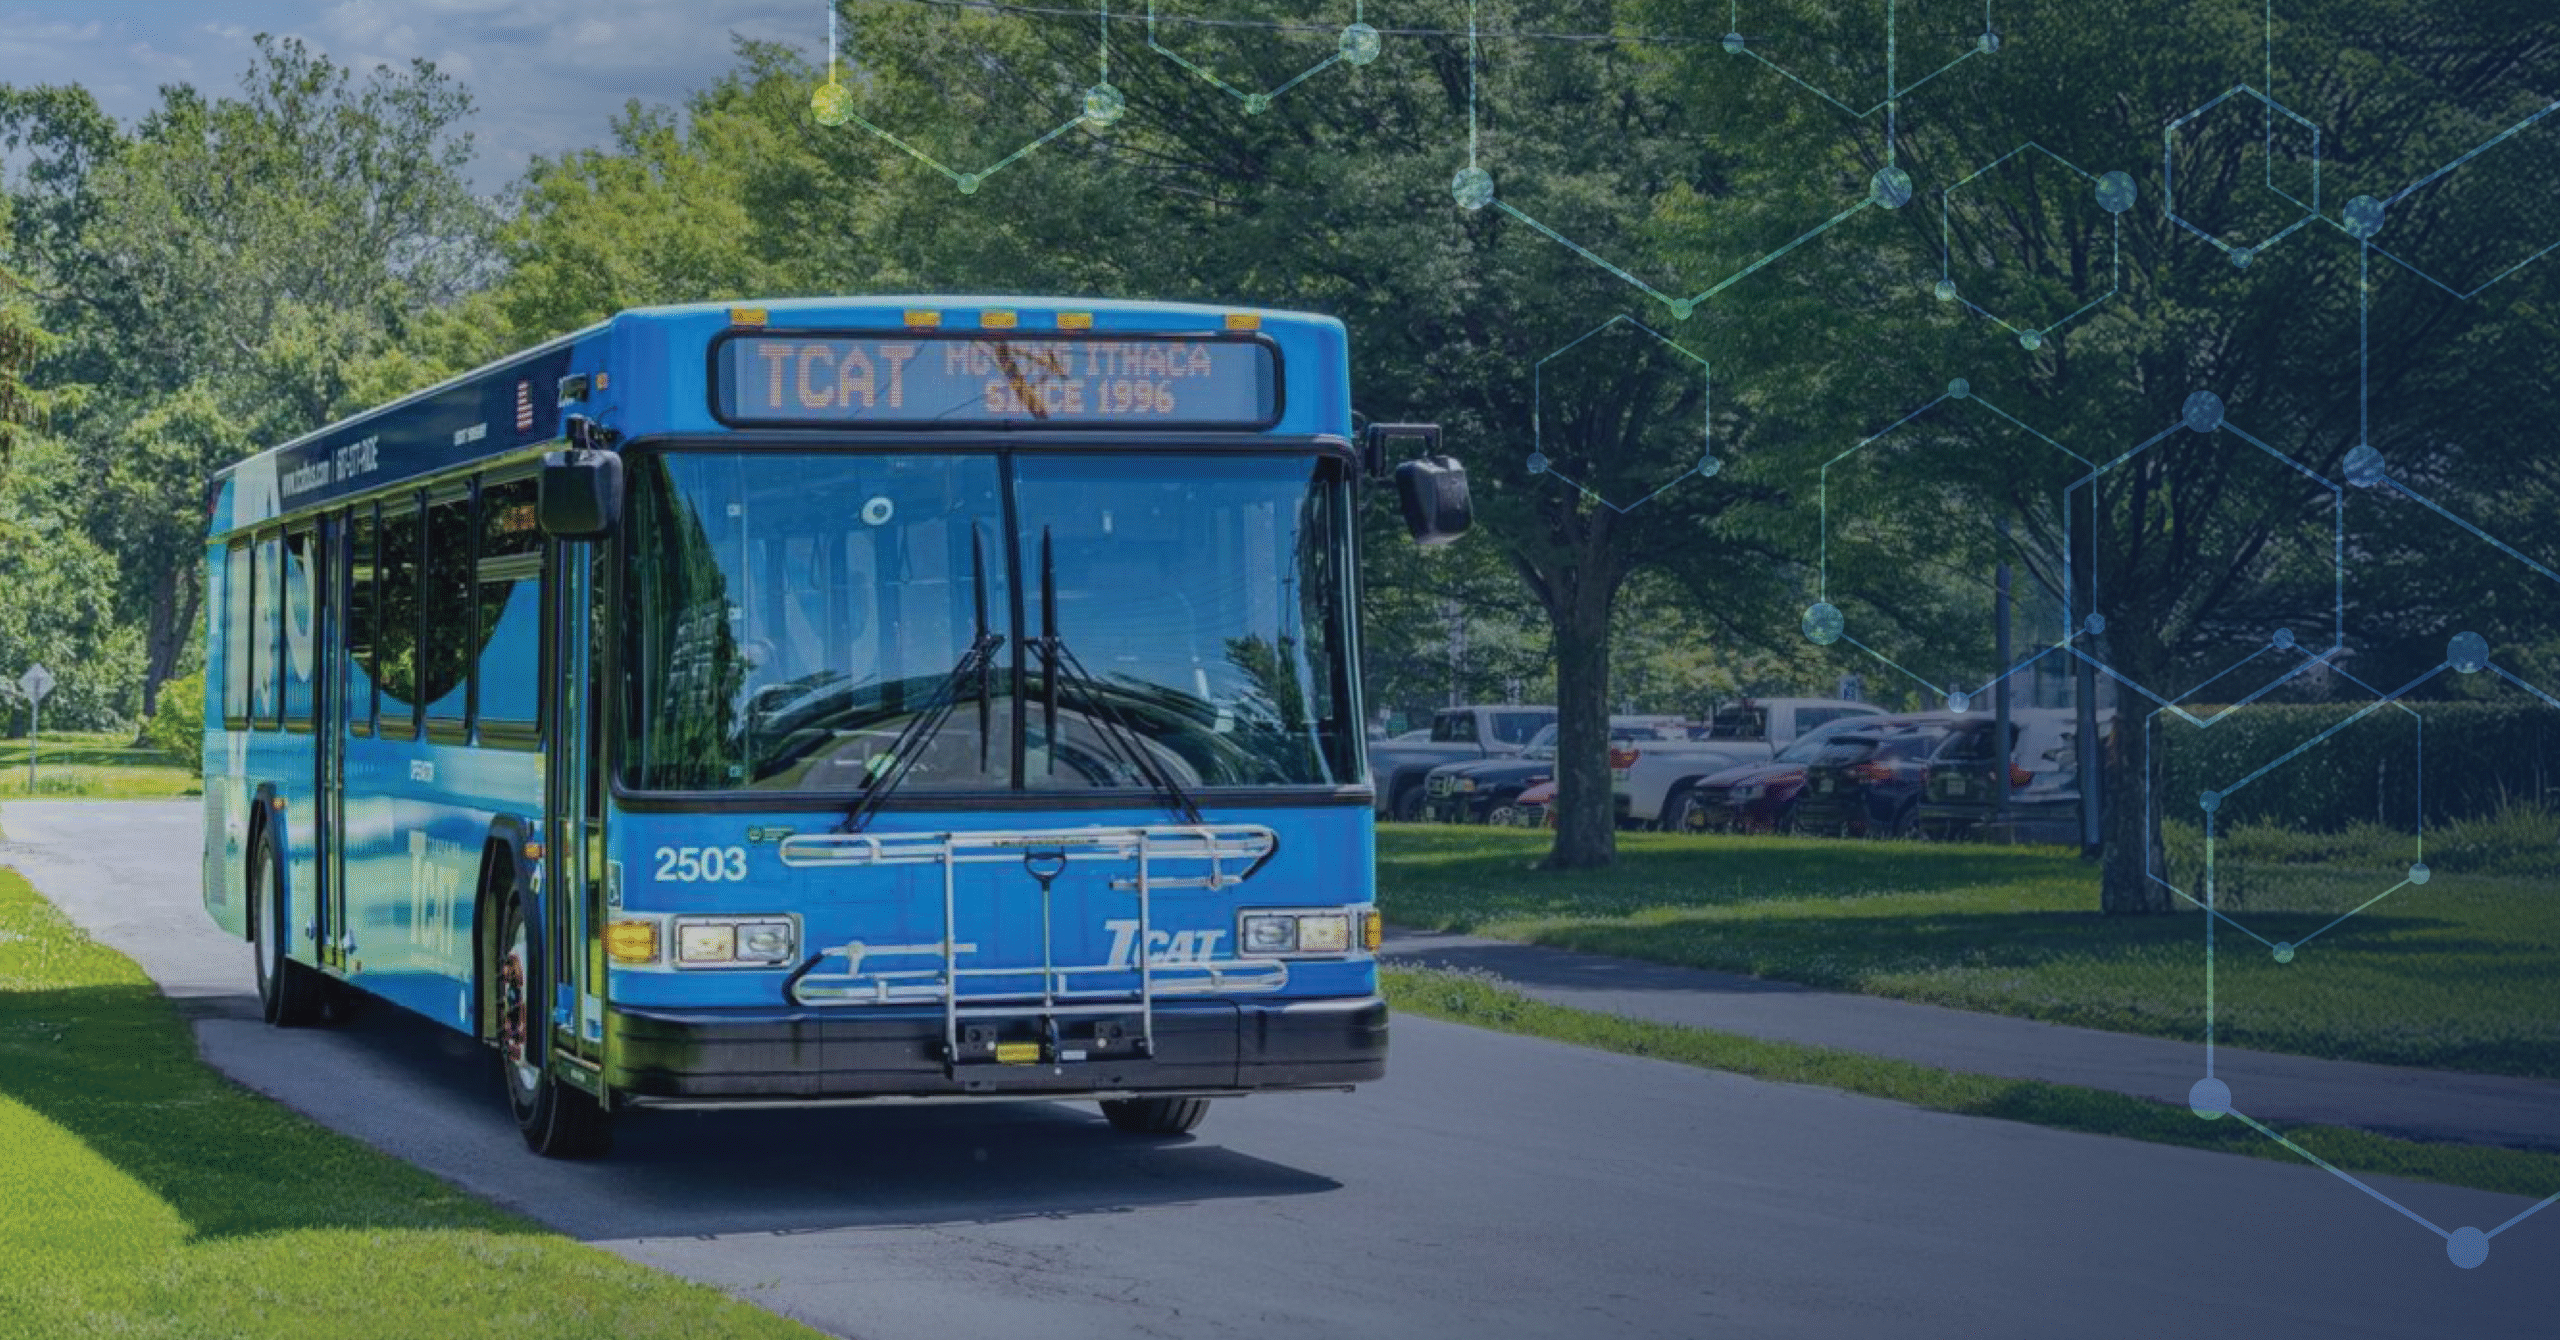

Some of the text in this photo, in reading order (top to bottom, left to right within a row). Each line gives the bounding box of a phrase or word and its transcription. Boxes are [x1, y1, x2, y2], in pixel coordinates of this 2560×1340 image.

[1087, 341, 1211, 376] ITHACA
[759, 345, 915, 408] TCAT
[1098, 379, 1175, 413] 1996
[655, 846, 747, 882] 2503
